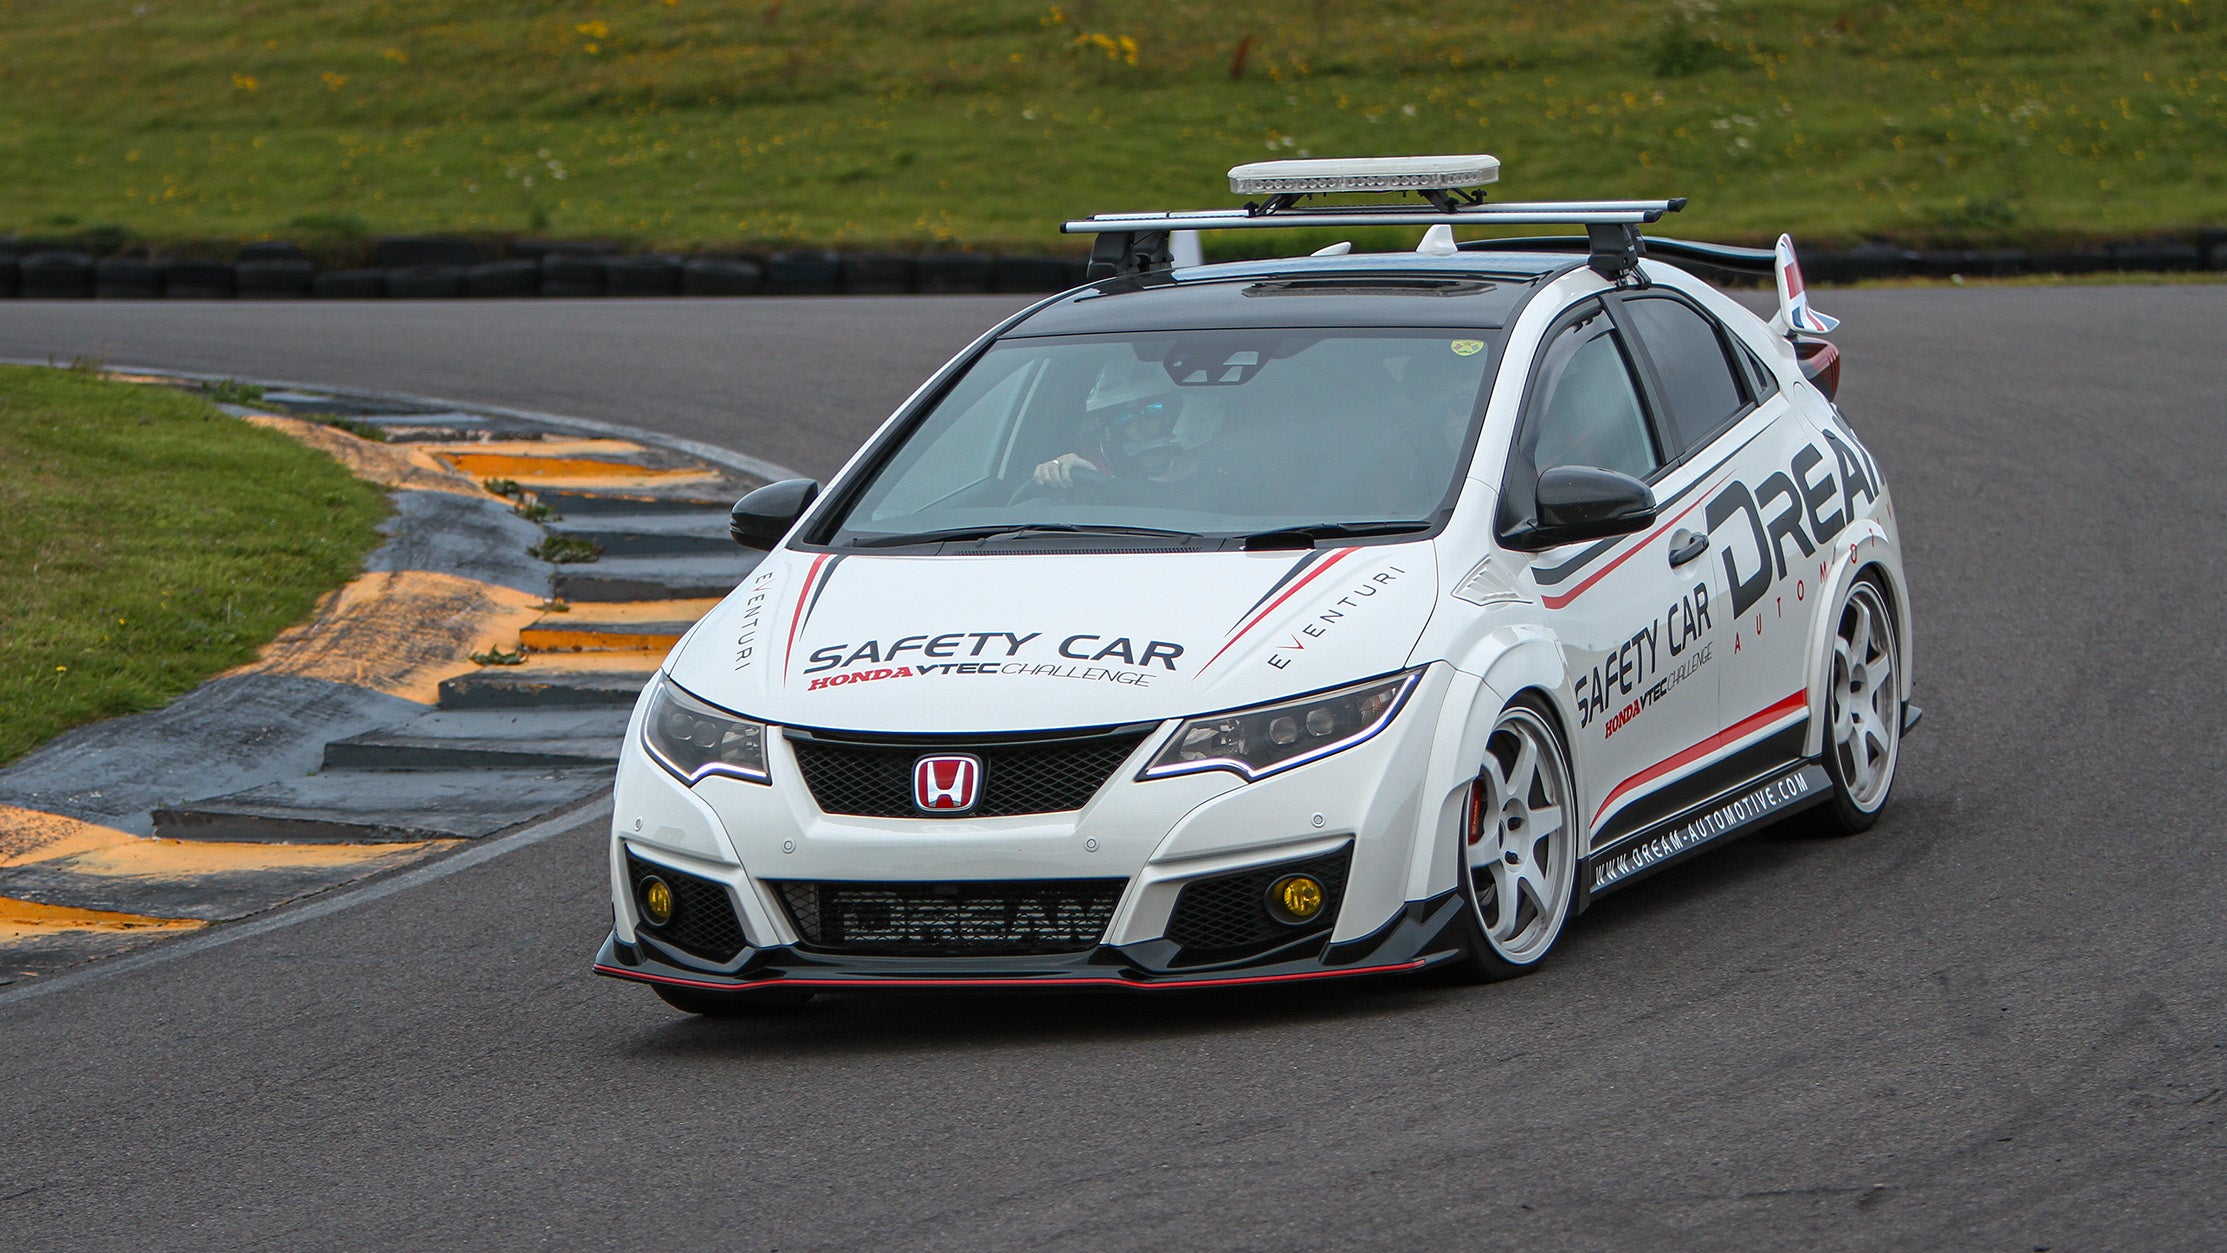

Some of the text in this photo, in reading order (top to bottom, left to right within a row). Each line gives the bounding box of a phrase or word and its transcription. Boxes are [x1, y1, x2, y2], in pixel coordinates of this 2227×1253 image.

[734, 572, 775, 671] EVENTURI
[803, 632, 1185, 675] SAFETY CAR
[1267, 566, 1406, 670] EVENTURI
[1574, 582, 1712, 729] SAFETY CAR
[1595, 772, 1808, 887] WWW.DREAM-AUTOMOTIVE.COM
